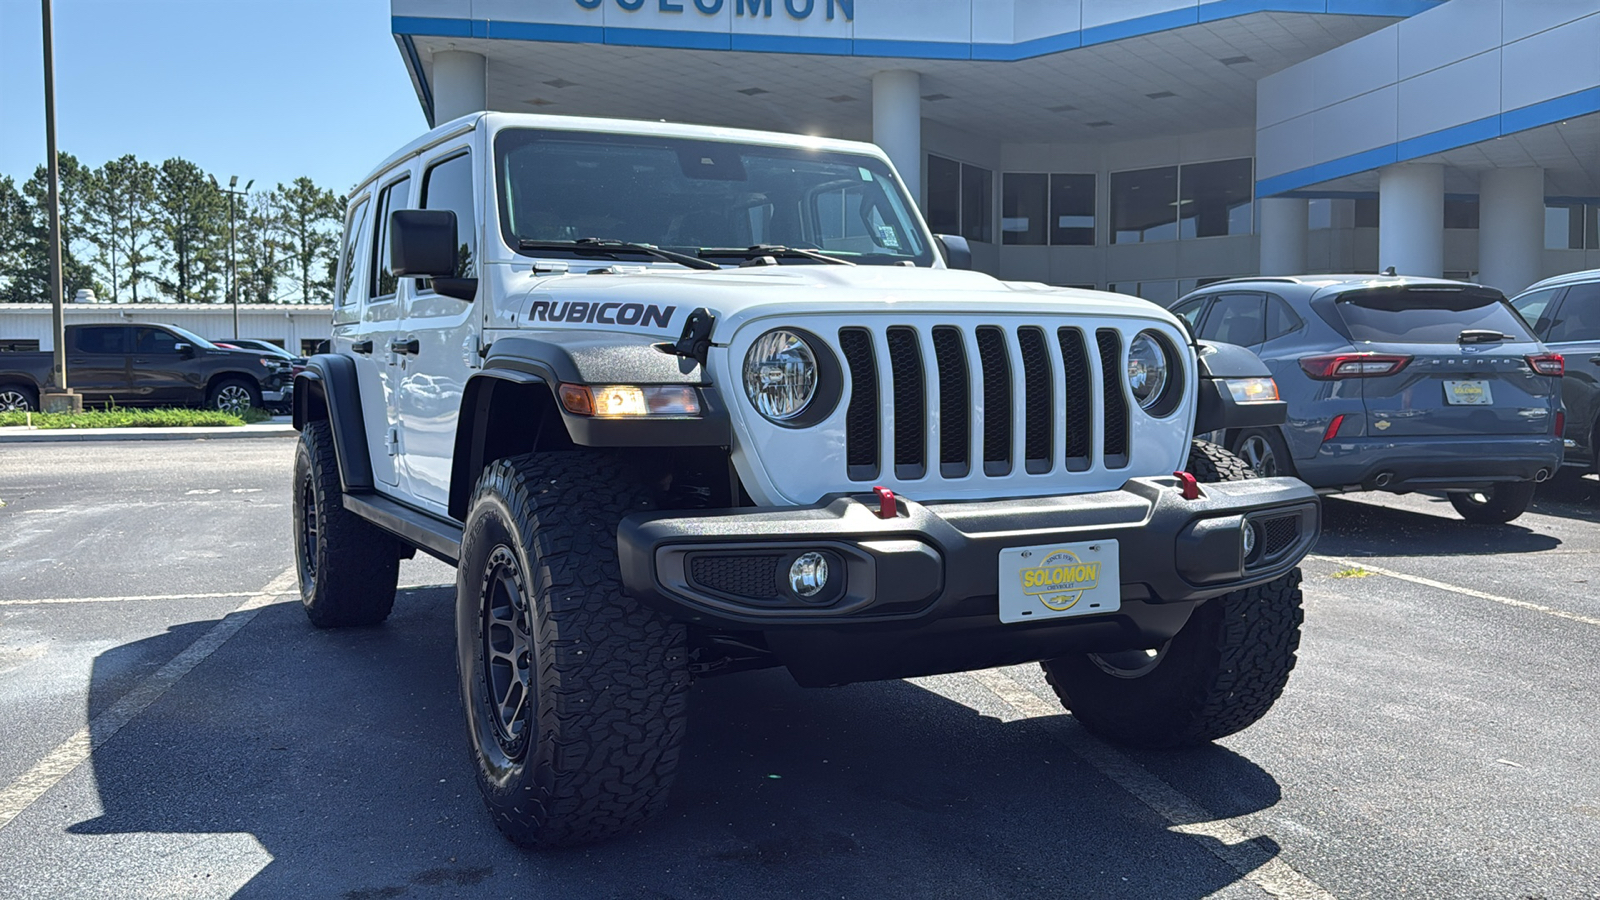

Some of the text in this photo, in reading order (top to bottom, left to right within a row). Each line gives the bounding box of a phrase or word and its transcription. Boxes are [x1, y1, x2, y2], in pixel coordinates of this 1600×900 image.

[528, 301, 676, 328] RUBICON
[1046, 554, 1062, 564] SINCE
[1024, 565, 1096, 587] SOLOMON
